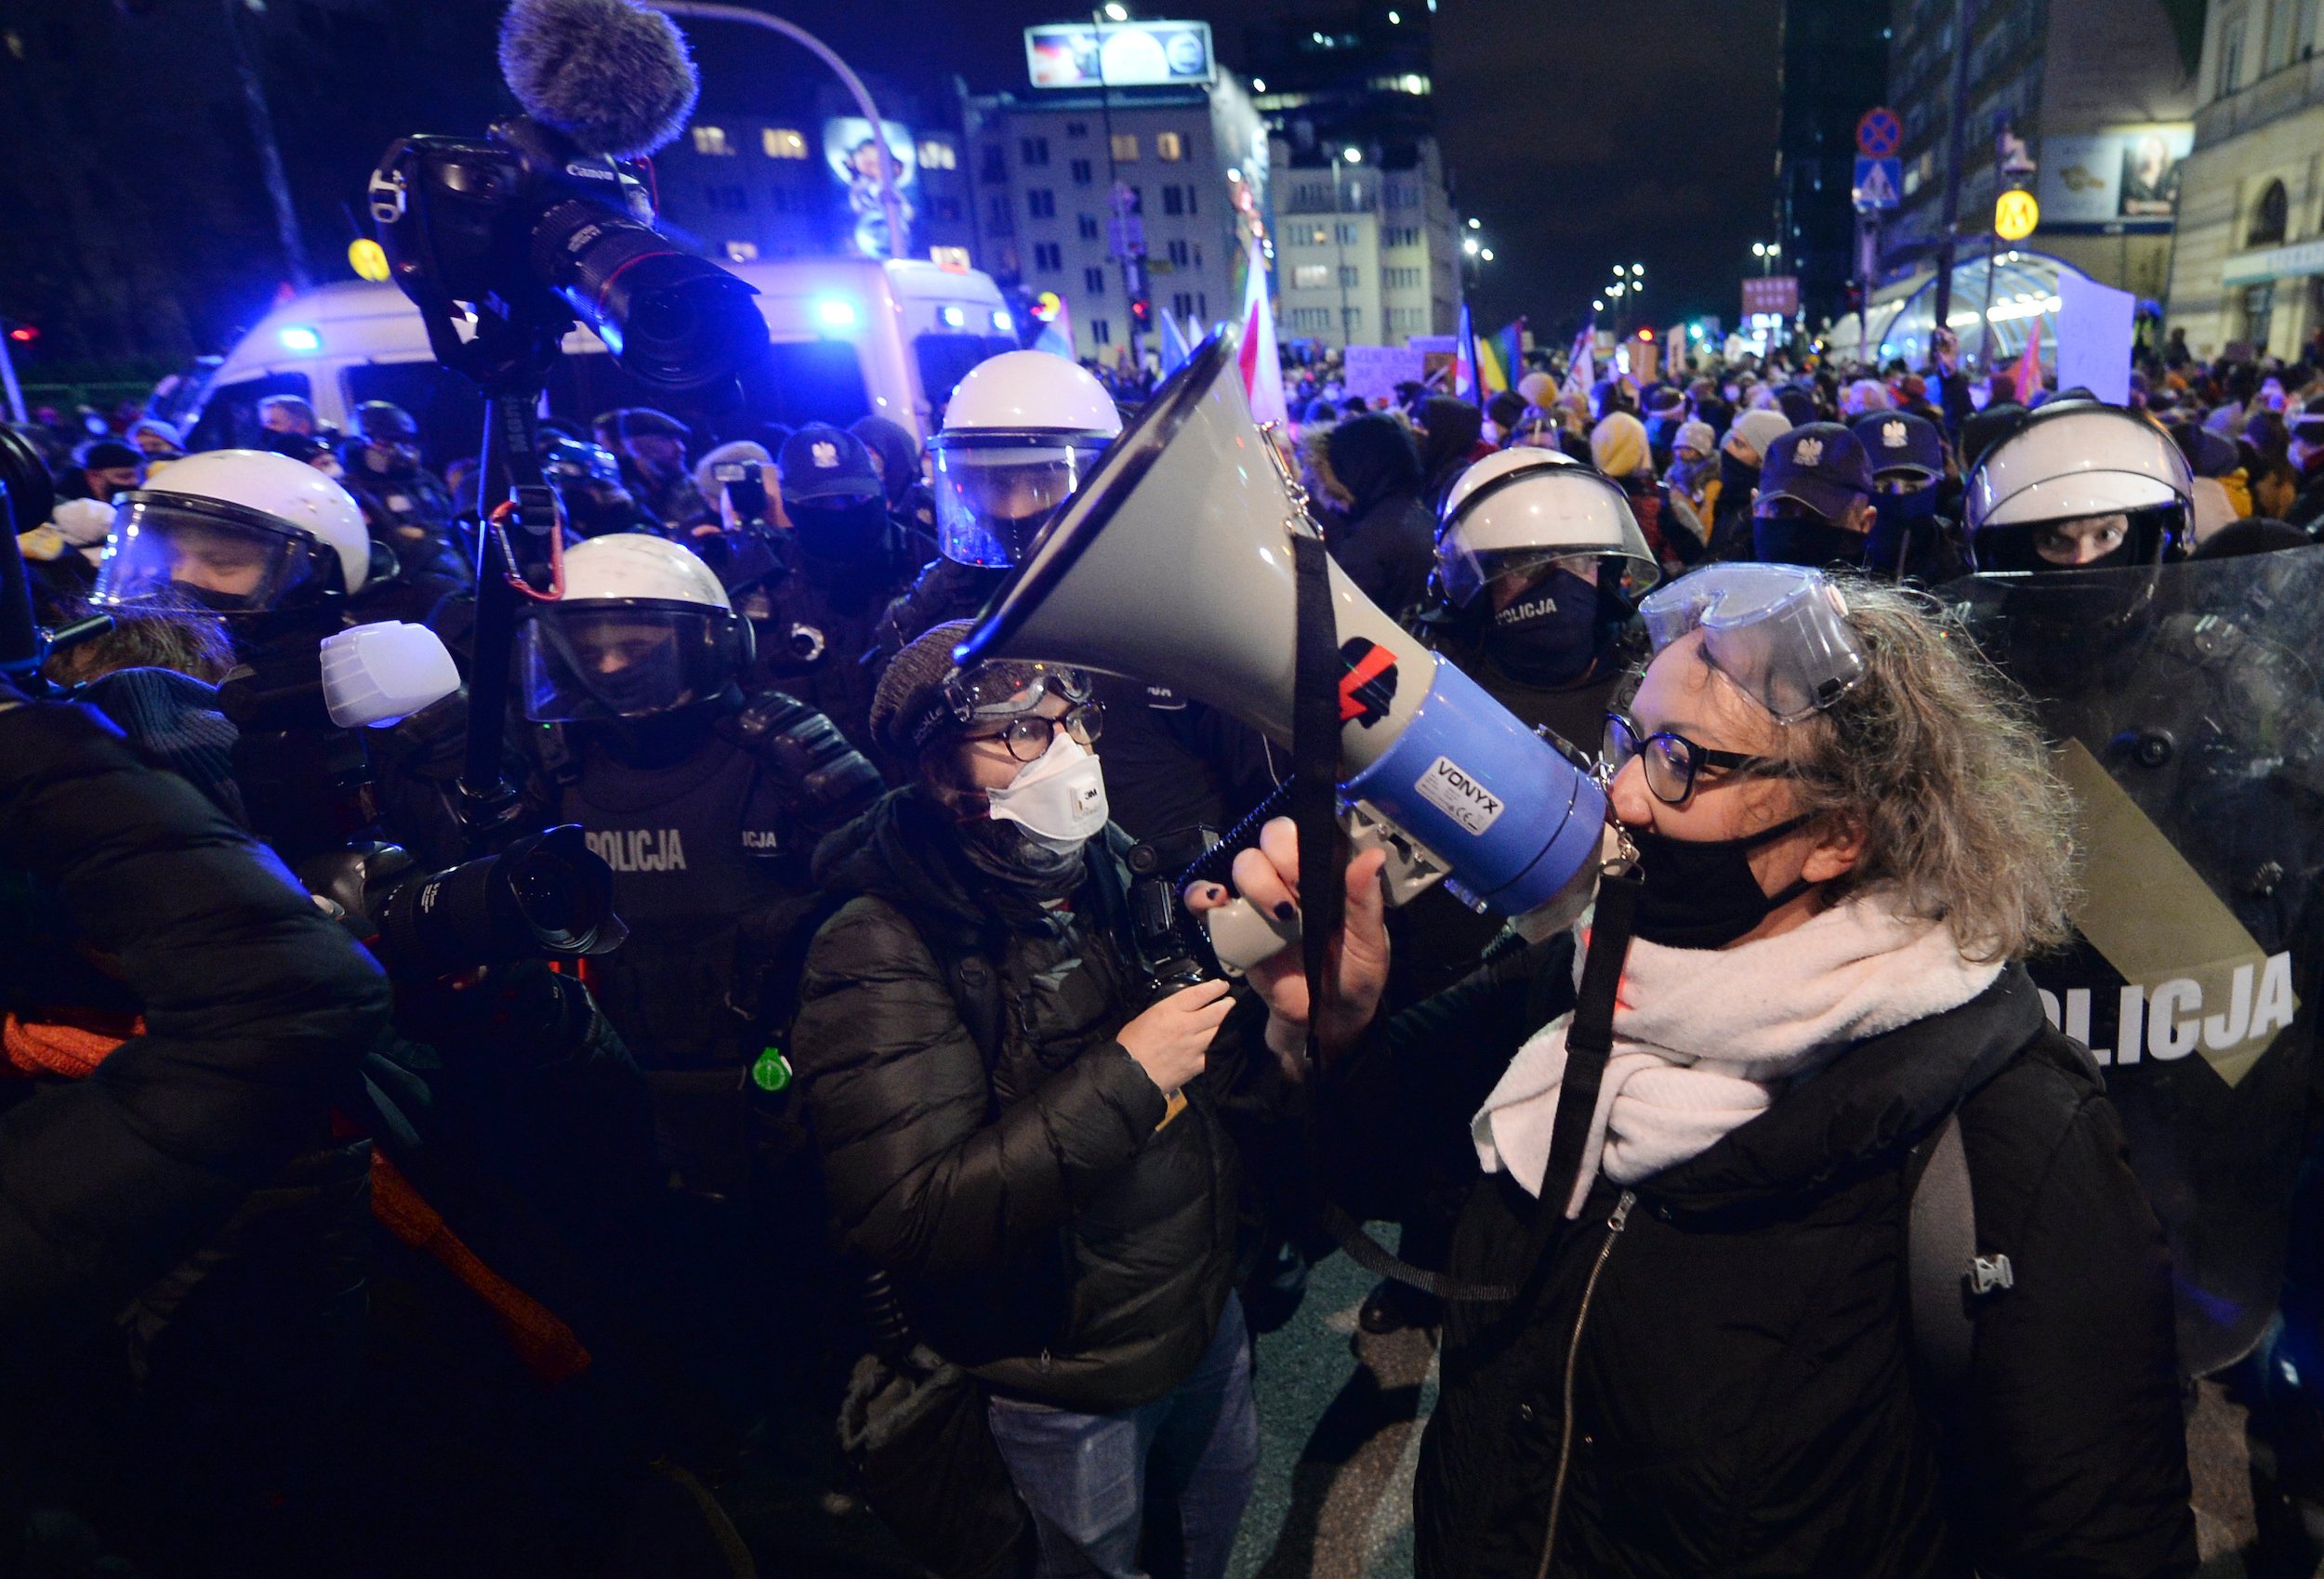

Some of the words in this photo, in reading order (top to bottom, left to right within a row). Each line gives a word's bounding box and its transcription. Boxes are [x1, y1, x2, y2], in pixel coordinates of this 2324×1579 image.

[565, 164, 614, 181] Canon
[1084, 788, 1098, 800] 3M
[1437, 760, 1499, 814] VONYX
[585, 829, 687, 872] POLICJA
